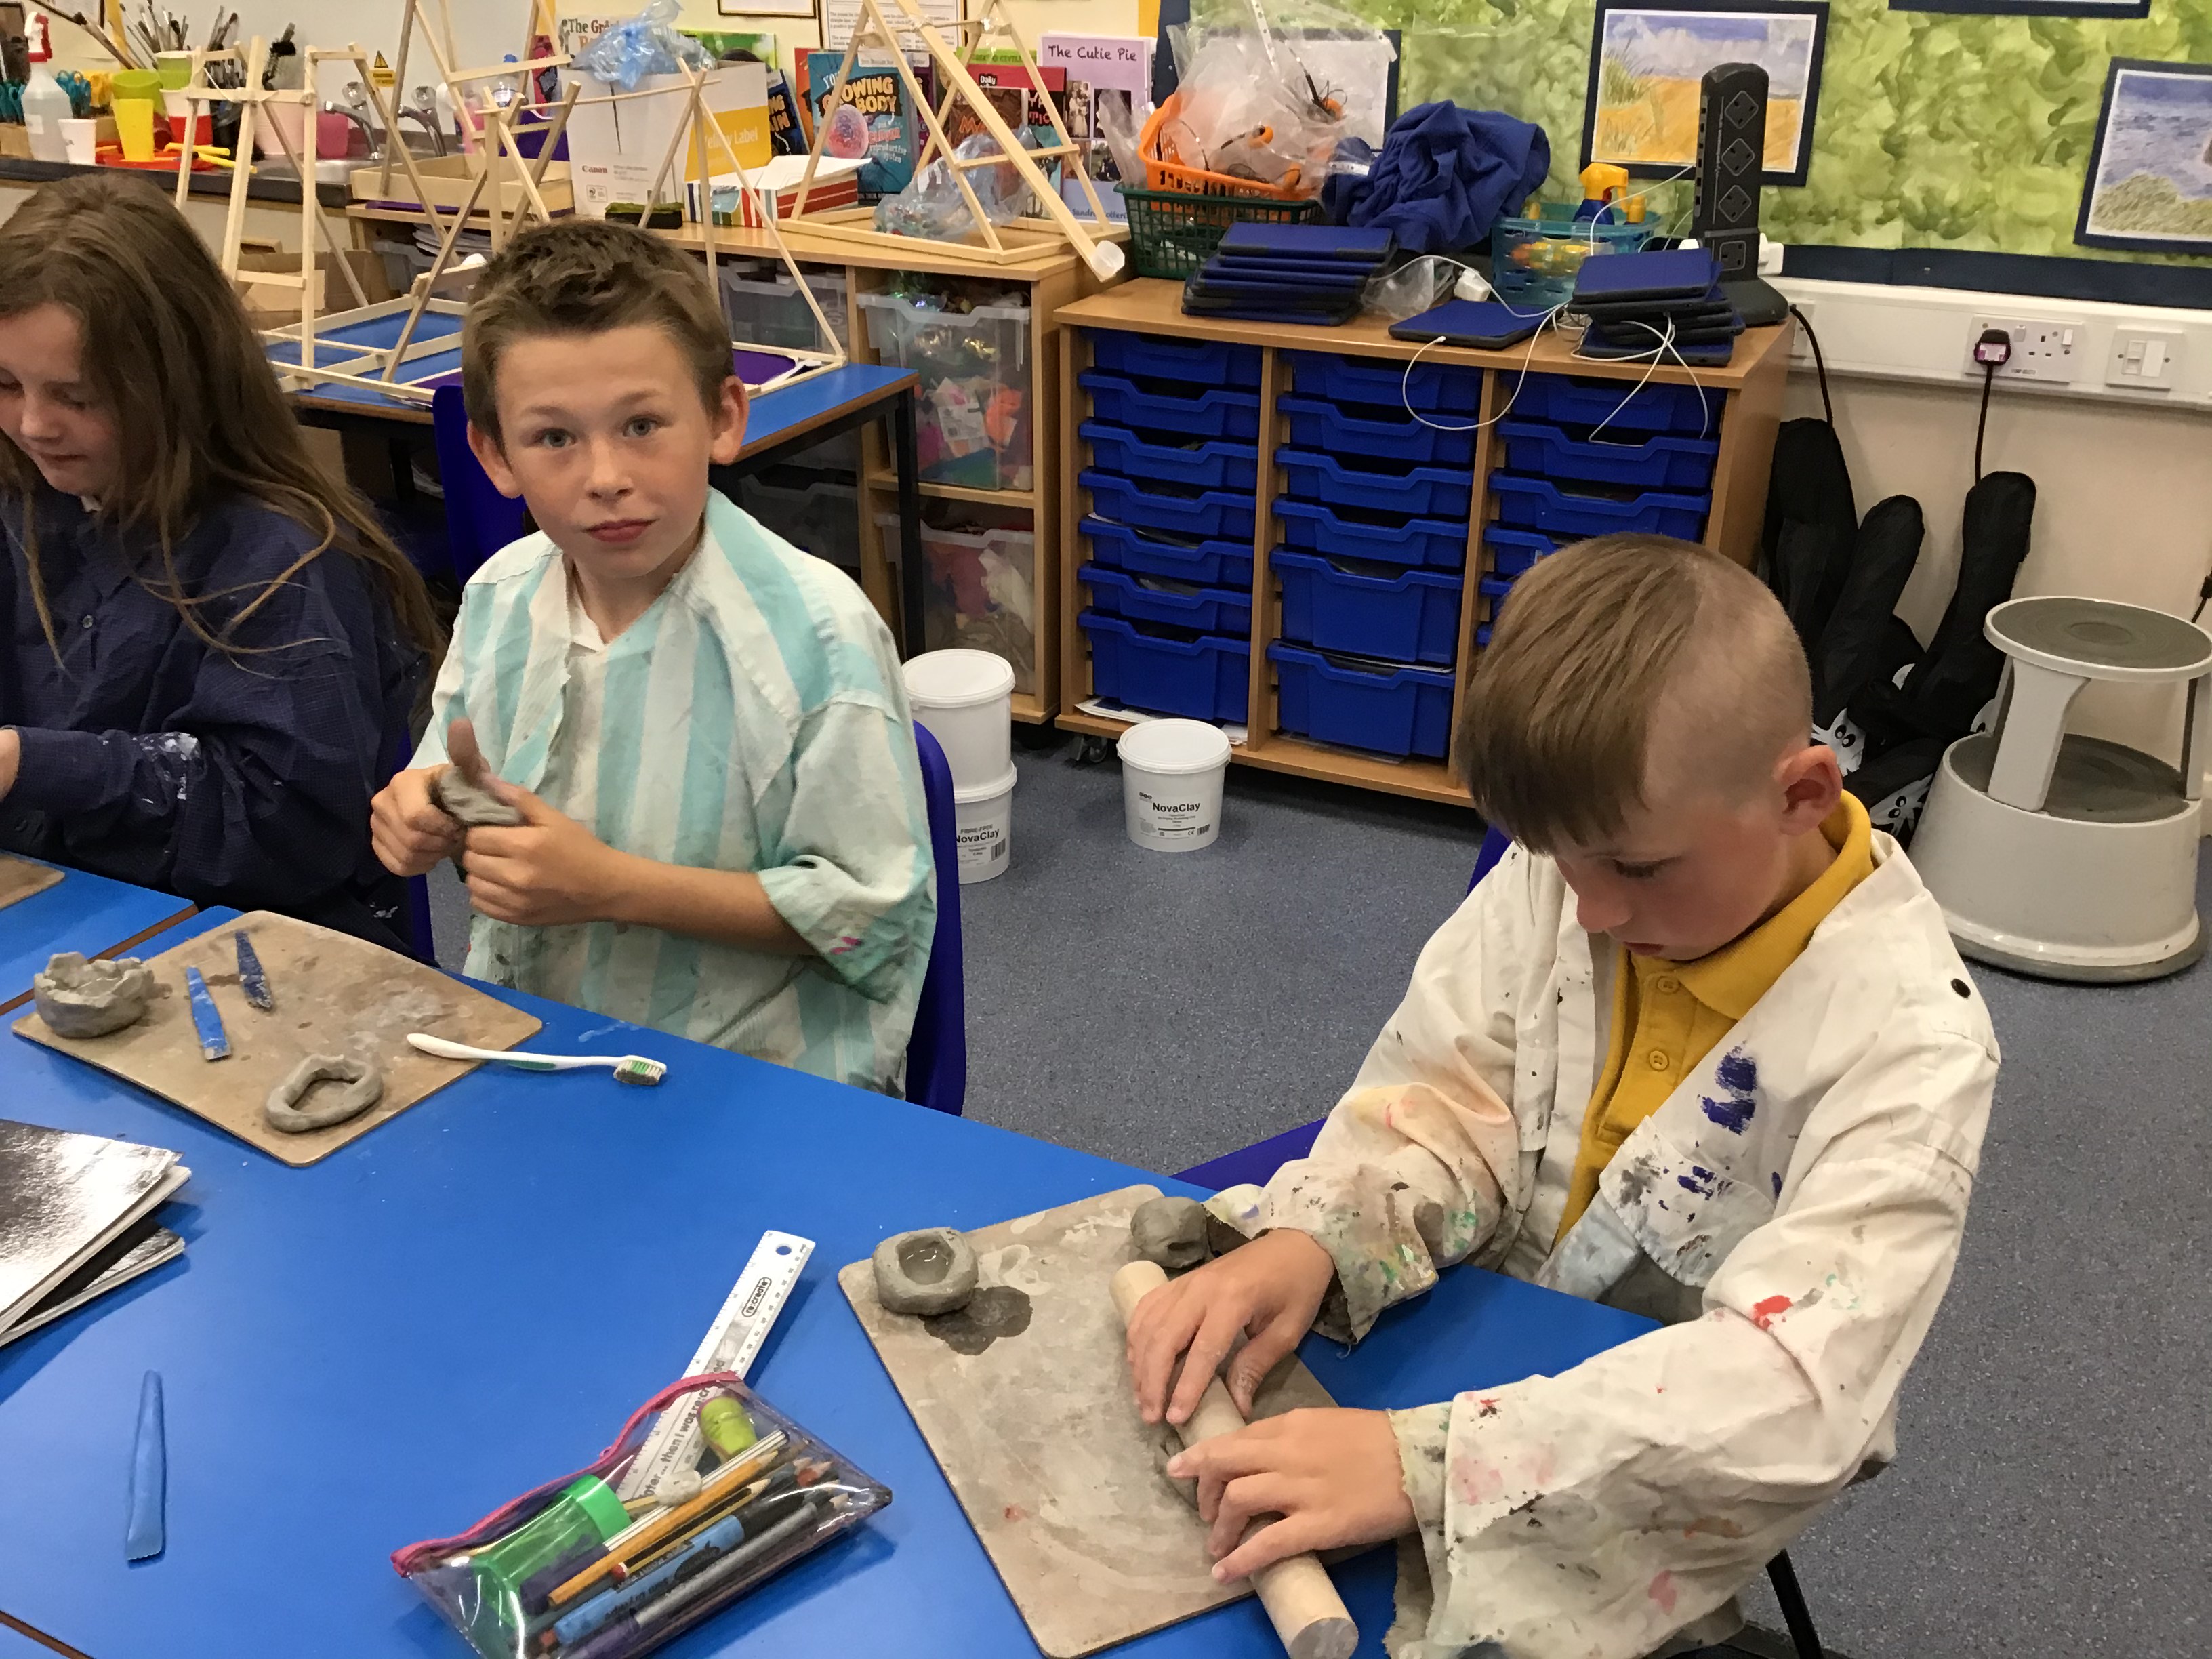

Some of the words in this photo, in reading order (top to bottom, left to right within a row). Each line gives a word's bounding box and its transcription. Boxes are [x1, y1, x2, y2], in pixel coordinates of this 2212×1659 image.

[568, 18, 588, 33] The
[1048, 45, 1072, 58] The
[1077, 46, 1112, 60] Cutie
[1117, 47, 1137, 62] Pie
[822, 76, 893, 110] GOWING
[855, 95, 897, 114] BODY
[734, 126, 758, 144] Label
[582, 165, 607, 173] Canon
[1153, 802, 1200, 813] NovaClay
[660, 1439, 682, 1463] than
